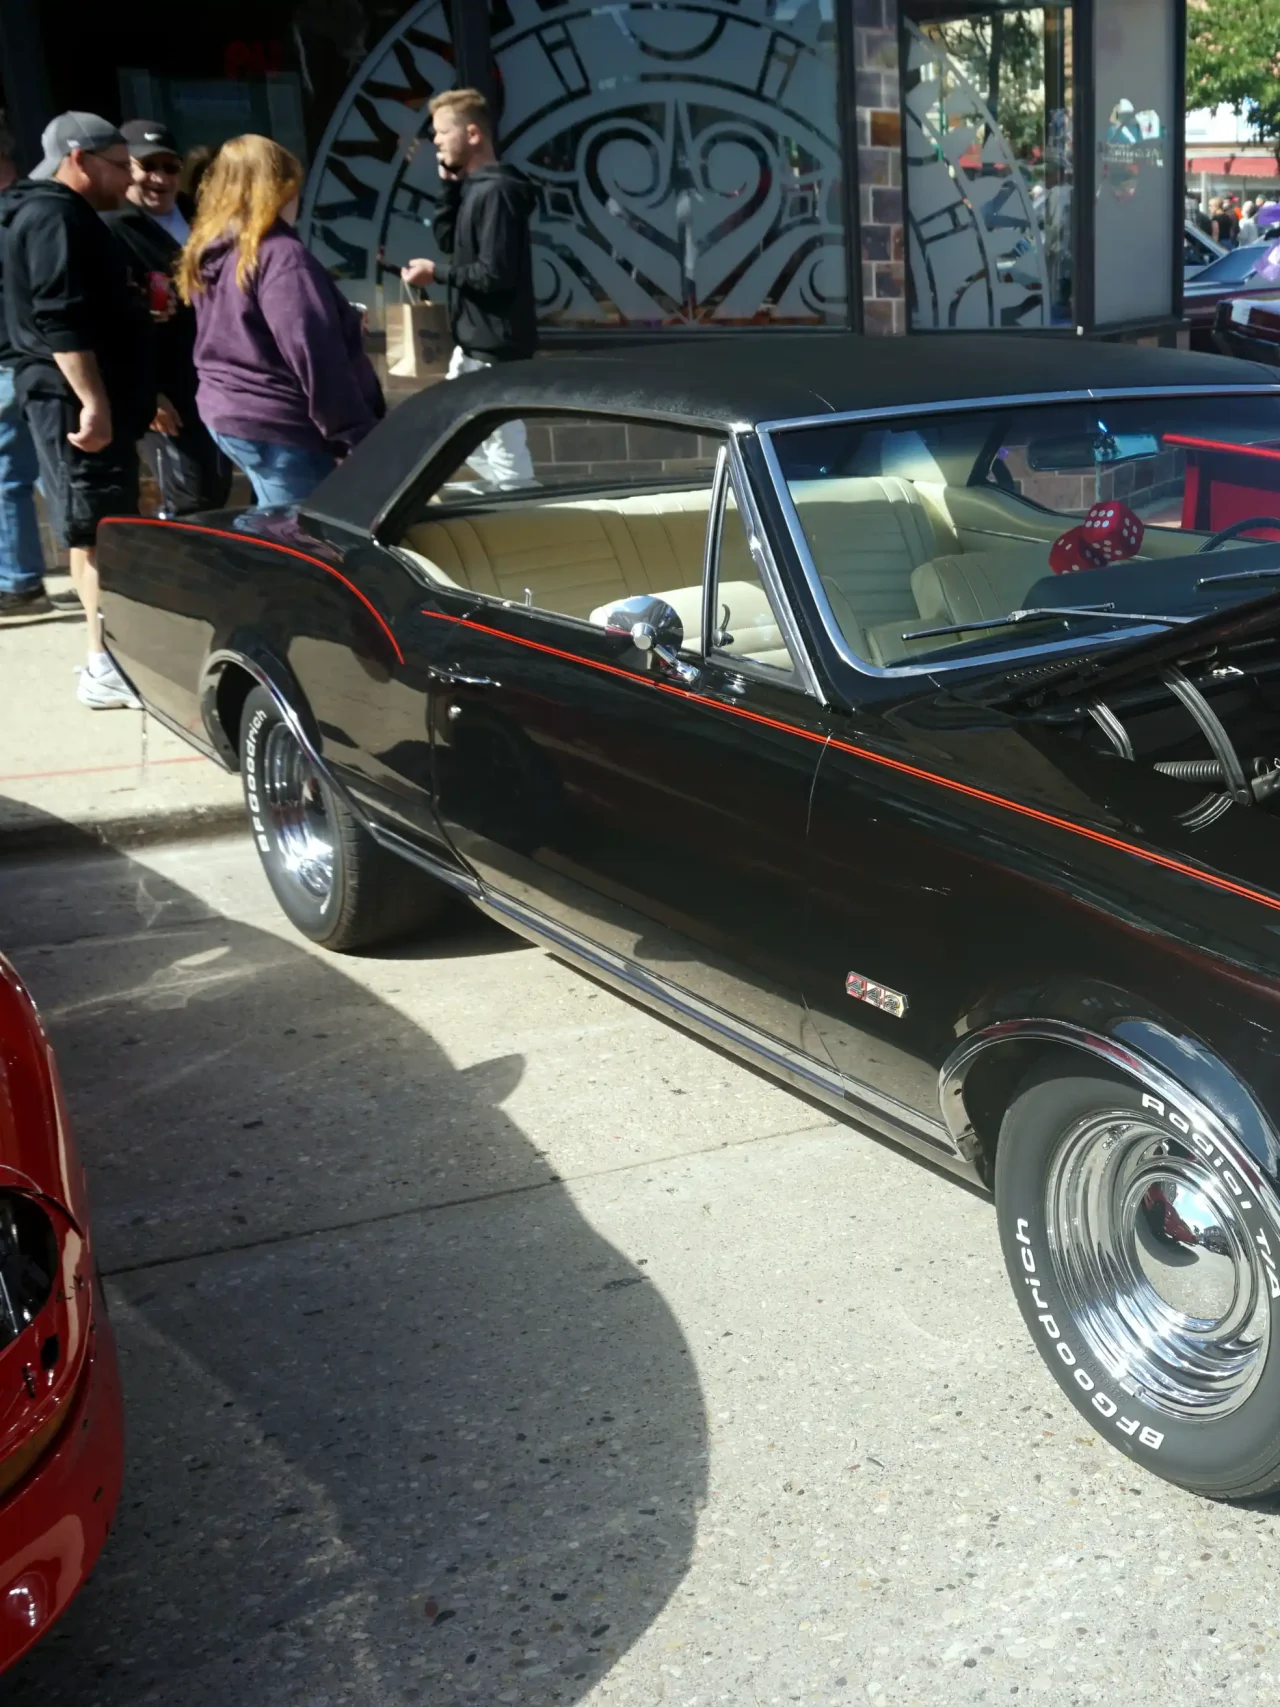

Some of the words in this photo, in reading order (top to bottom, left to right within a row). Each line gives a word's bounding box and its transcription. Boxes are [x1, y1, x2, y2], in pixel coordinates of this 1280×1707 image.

[847, 977, 902, 1017] 442
[1141, 1093, 1252, 1210] Radial
[1255, 1227, 1280, 1299] T/A
[1015, 1217, 1165, 1450] BFGoodrich
